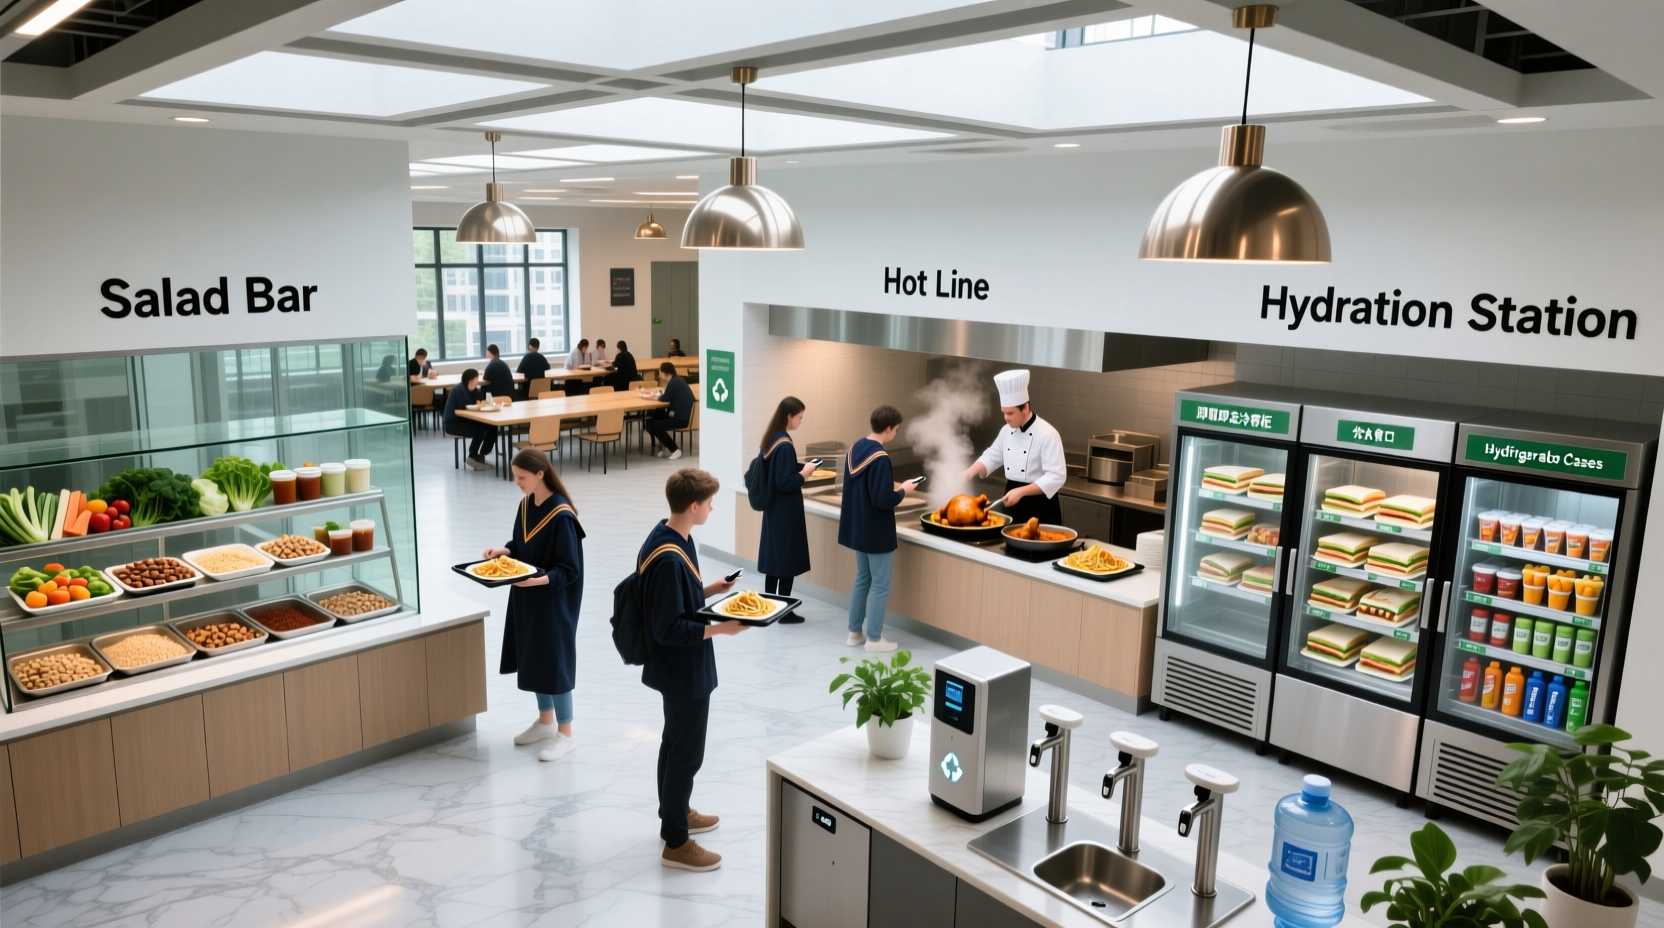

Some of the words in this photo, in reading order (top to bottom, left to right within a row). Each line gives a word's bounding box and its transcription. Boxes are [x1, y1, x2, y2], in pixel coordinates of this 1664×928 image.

[100, 276, 230, 319] Salad
[245, 276, 318, 314] Bar
[884, 266, 928, 297] Hot
[936, 269, 990, 301] Line
[1260, 284, 1453, 331] Hydration
[1467, 292, 1638, 340] Station
